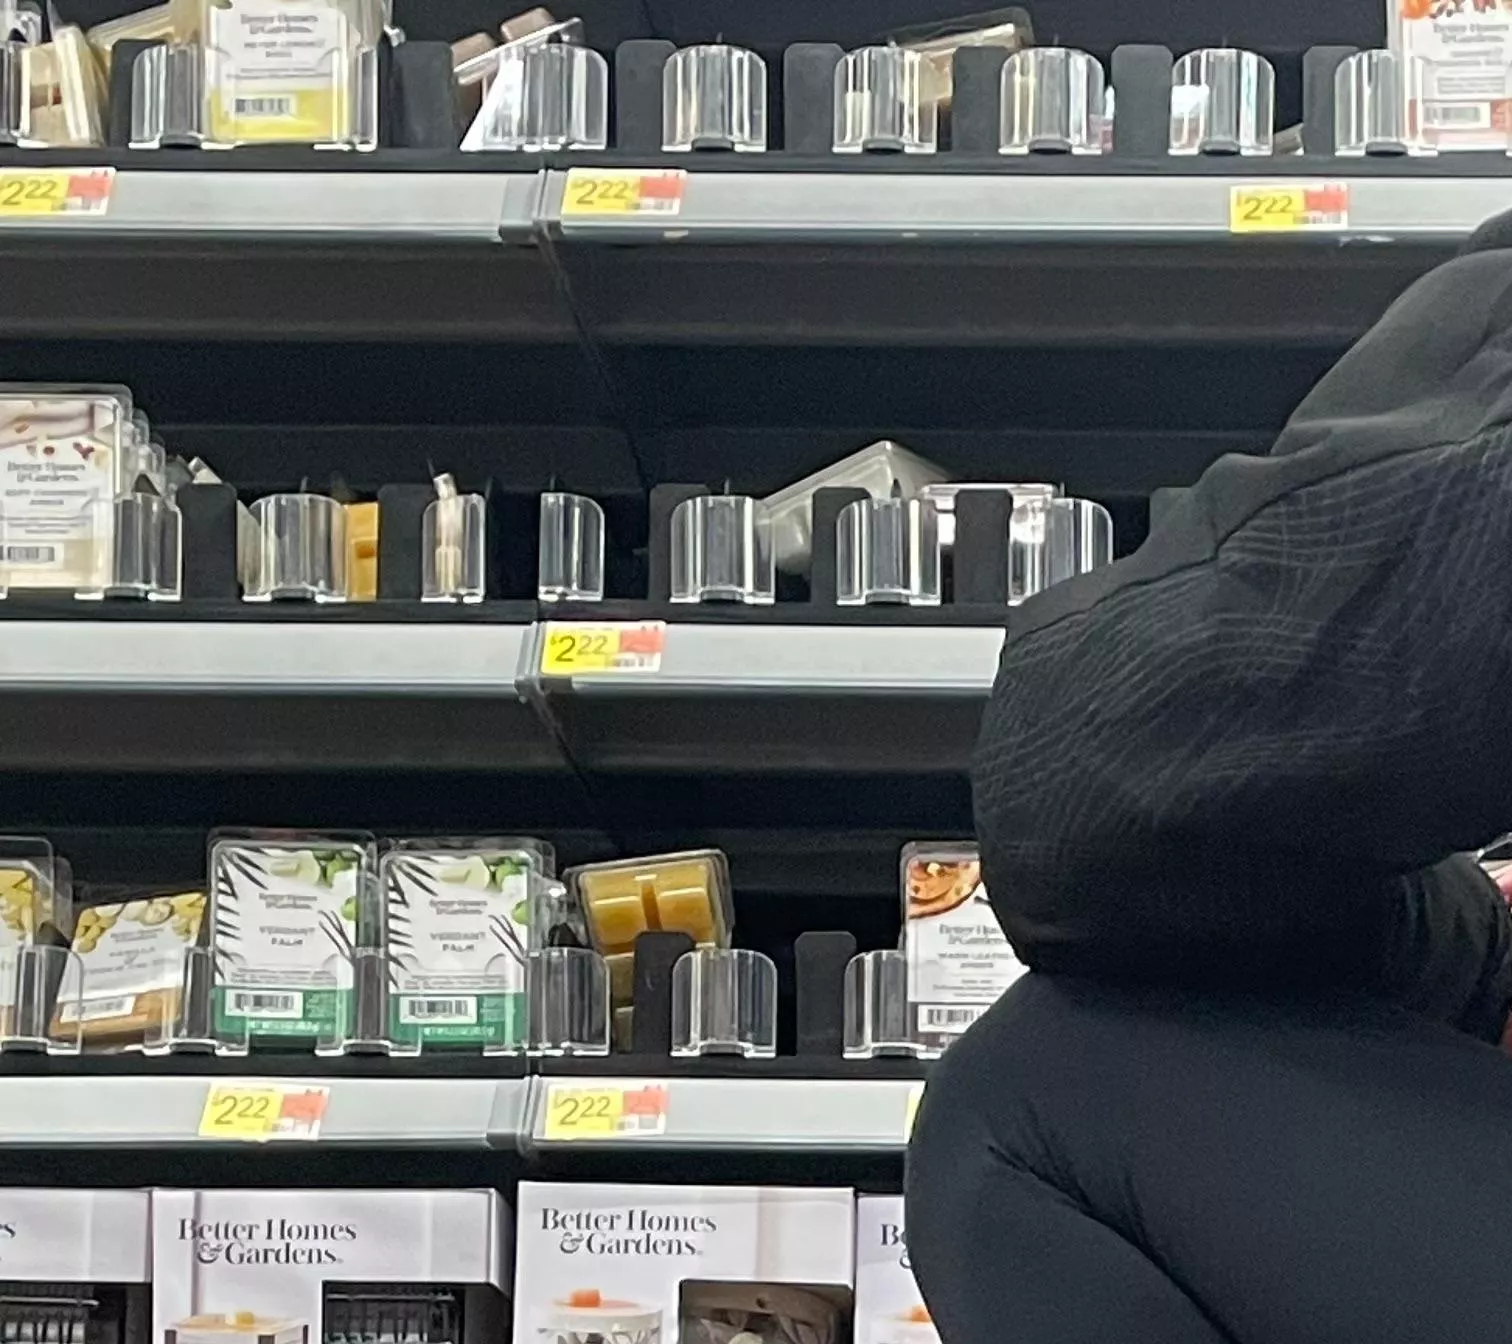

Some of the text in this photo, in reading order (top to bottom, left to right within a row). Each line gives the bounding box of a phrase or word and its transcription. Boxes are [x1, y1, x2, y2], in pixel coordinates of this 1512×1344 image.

[178, 1217, 358, 1242] Better Homes
[541, 1207, 718, 1233] Better Homes
